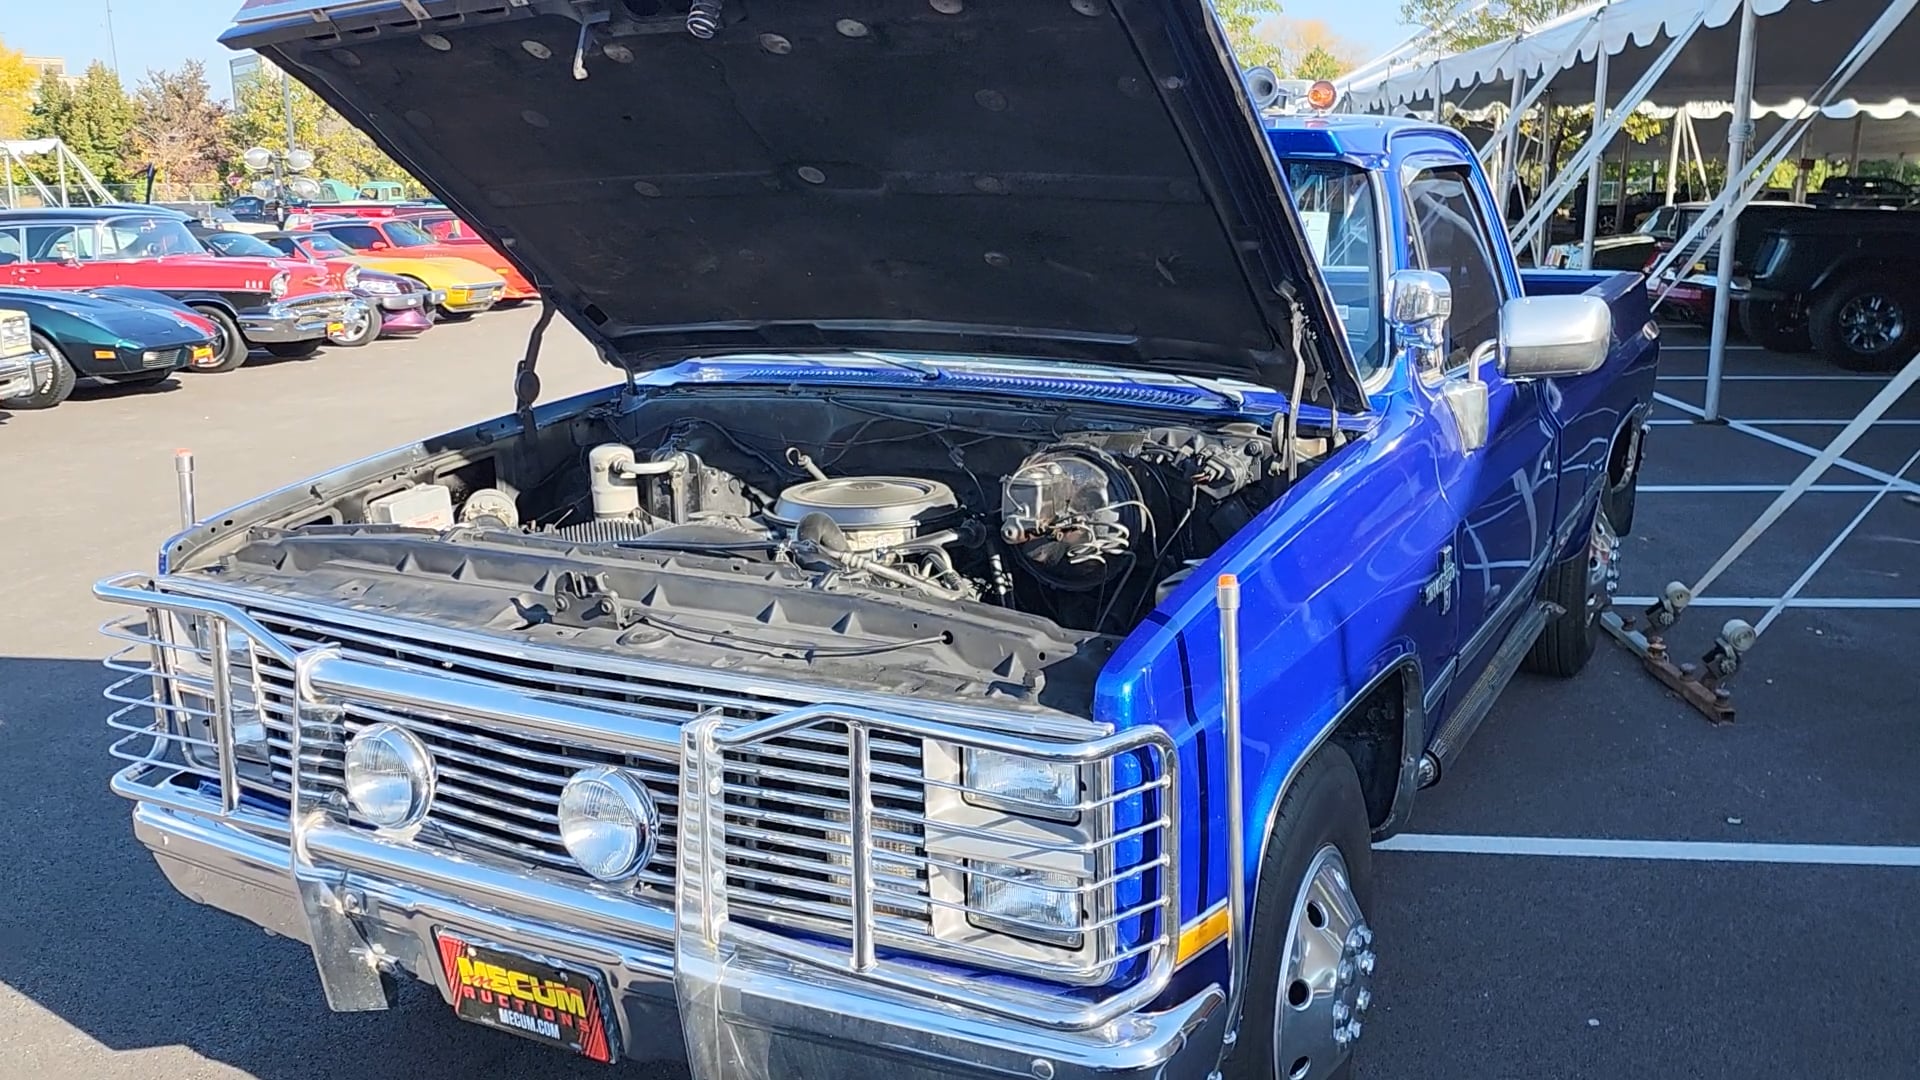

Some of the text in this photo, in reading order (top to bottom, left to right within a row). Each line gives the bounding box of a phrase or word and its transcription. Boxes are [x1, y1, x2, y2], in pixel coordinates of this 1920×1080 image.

[457, 957, 587, 1017] MECUM
[463, 986, 590, 1033] AUCTIONS
[498, 1008, 561, 1040] MECUM.COM
